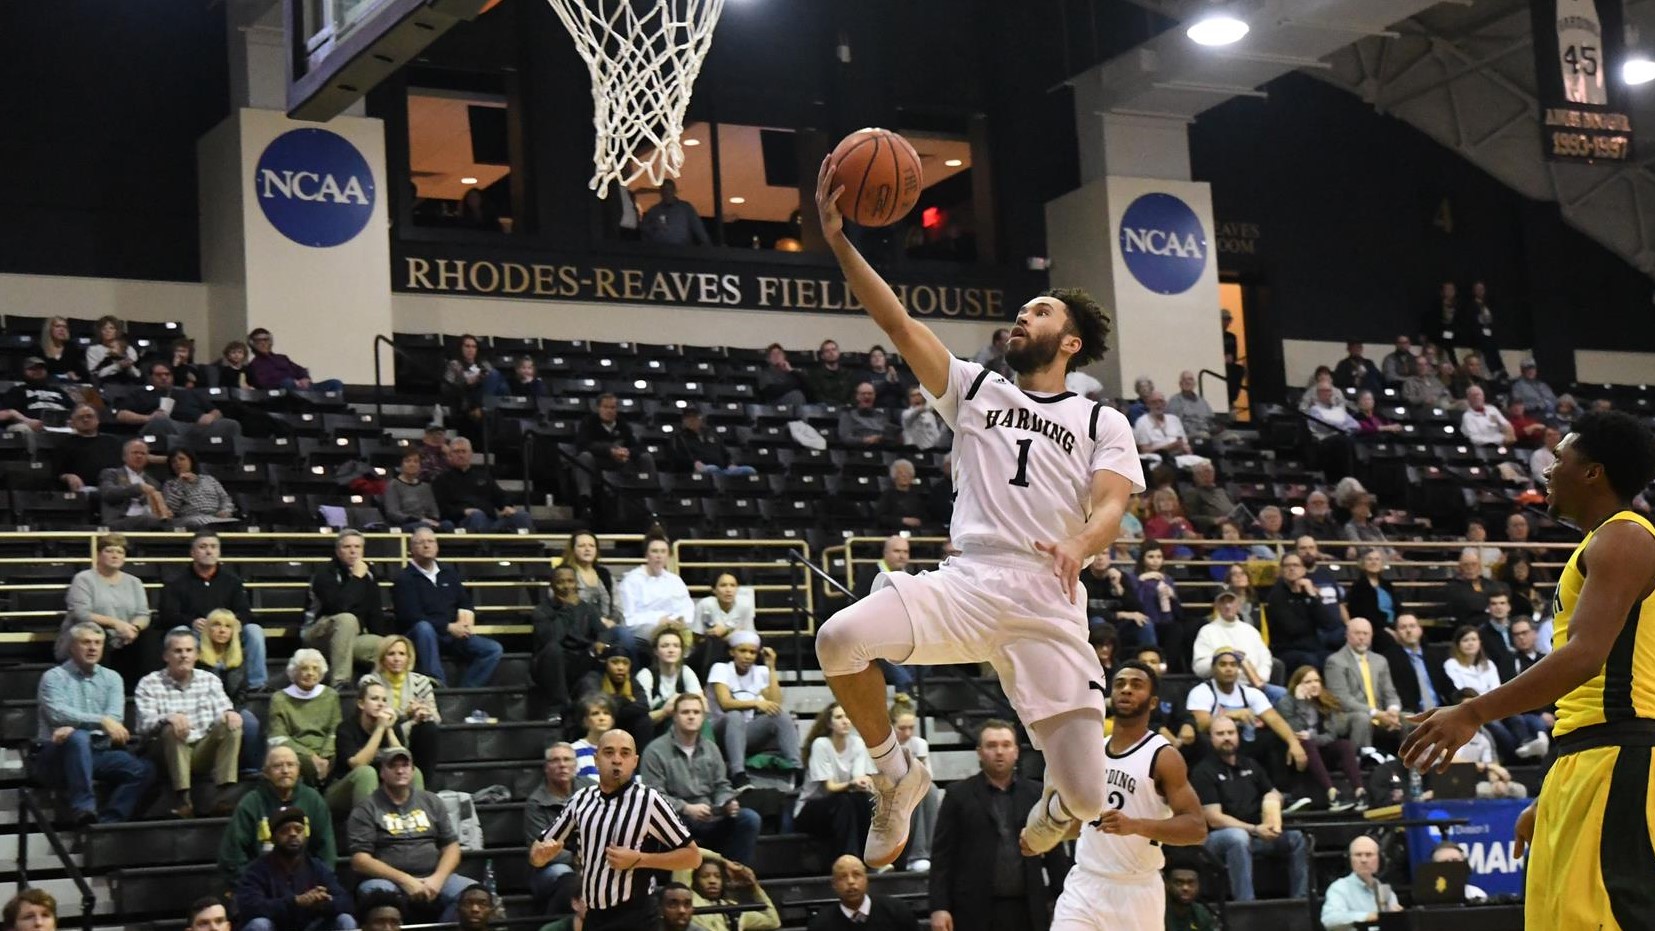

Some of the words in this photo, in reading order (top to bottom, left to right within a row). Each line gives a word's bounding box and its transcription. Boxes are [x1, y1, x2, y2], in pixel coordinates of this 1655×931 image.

[1564, 45, 1597, 76] 45
[261, 168, 370, 205] NCAA
[1123, 227, 1203, 259] NCAA
[406, 257, 741, 304] RHODES-REAVES
[985, 408, 1075, 455] HARDING
[1009, 438, 1032, 488] 1
[1105, 768, 1136, 794] DING
